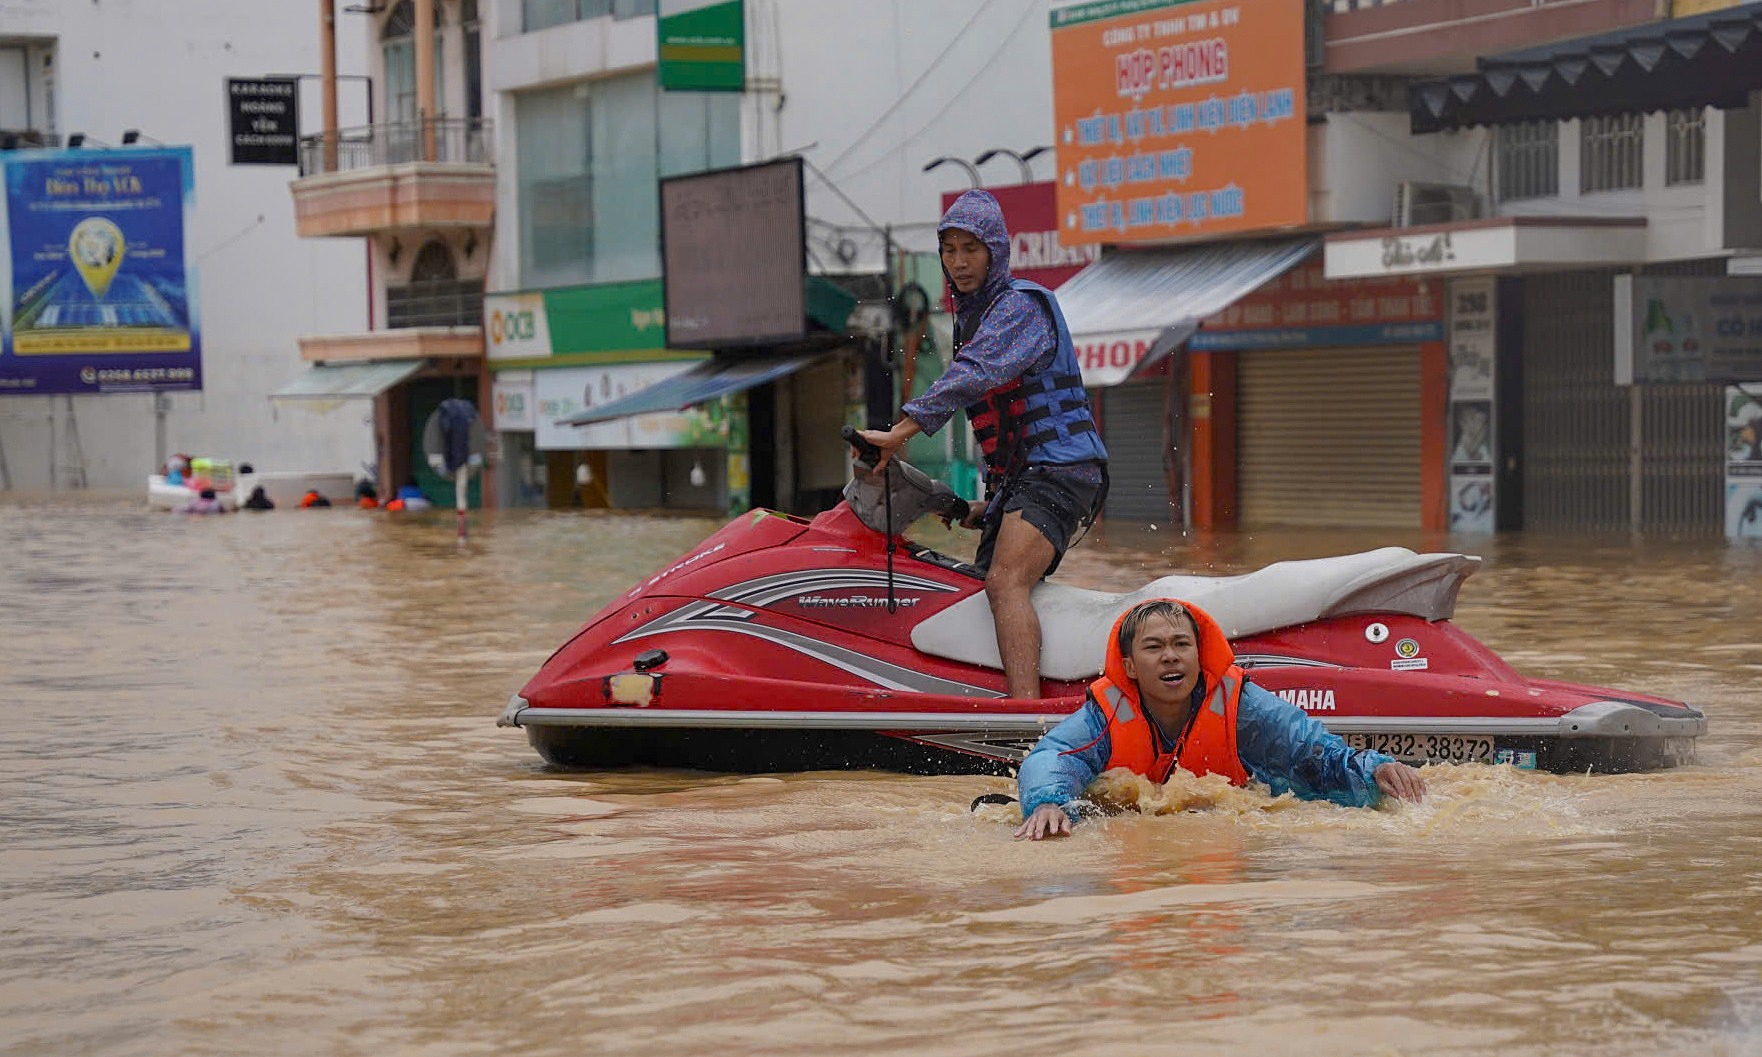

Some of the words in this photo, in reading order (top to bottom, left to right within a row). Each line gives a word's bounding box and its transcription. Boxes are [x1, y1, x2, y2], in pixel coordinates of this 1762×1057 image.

[1137, 25, 1150, 40] TY
[1159, 37, 1228, 90] PHONG
[231, 83, 292, 97] KARAOKE
[1378, 733, 1491, 760] 232-38372
